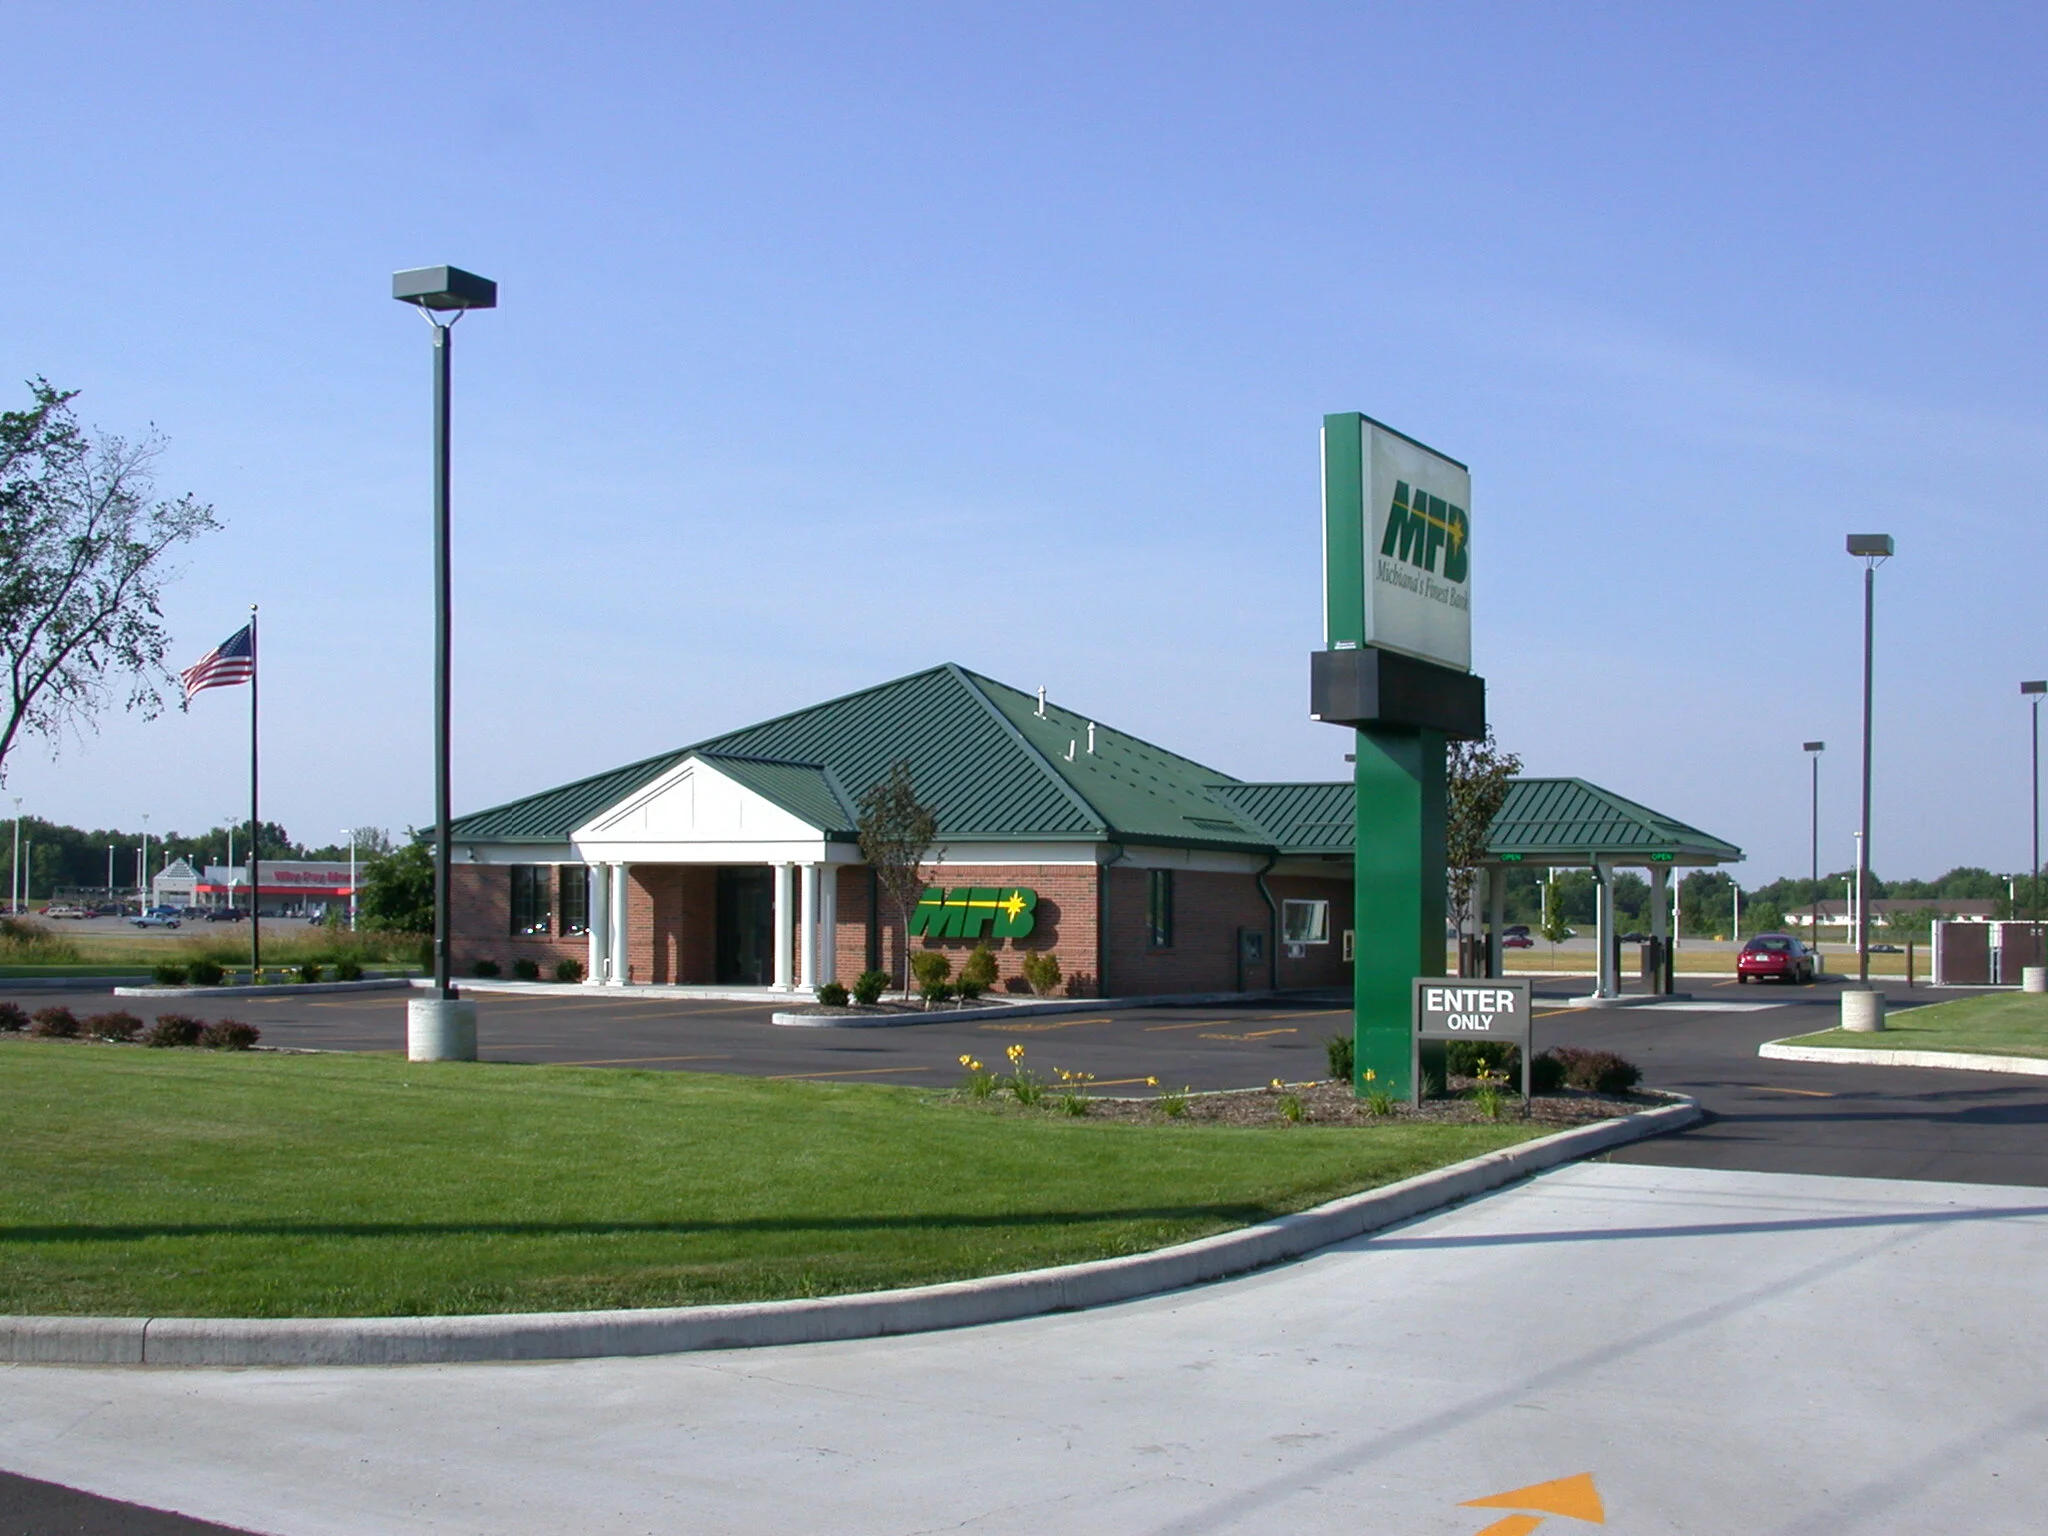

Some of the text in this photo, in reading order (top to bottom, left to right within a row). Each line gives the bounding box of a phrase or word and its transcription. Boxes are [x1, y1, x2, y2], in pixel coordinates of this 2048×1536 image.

[1381, 480, 1469, 584] MFB
[1501, 853, 1521, 861] OPEN
[1651, 853, 1672, 861] OPEN
[910, 887, 1038, 938] MFB
[1427, 989, 1514, 1012] ENTER
[1447, 1014, 1493, 1030] ONLY
